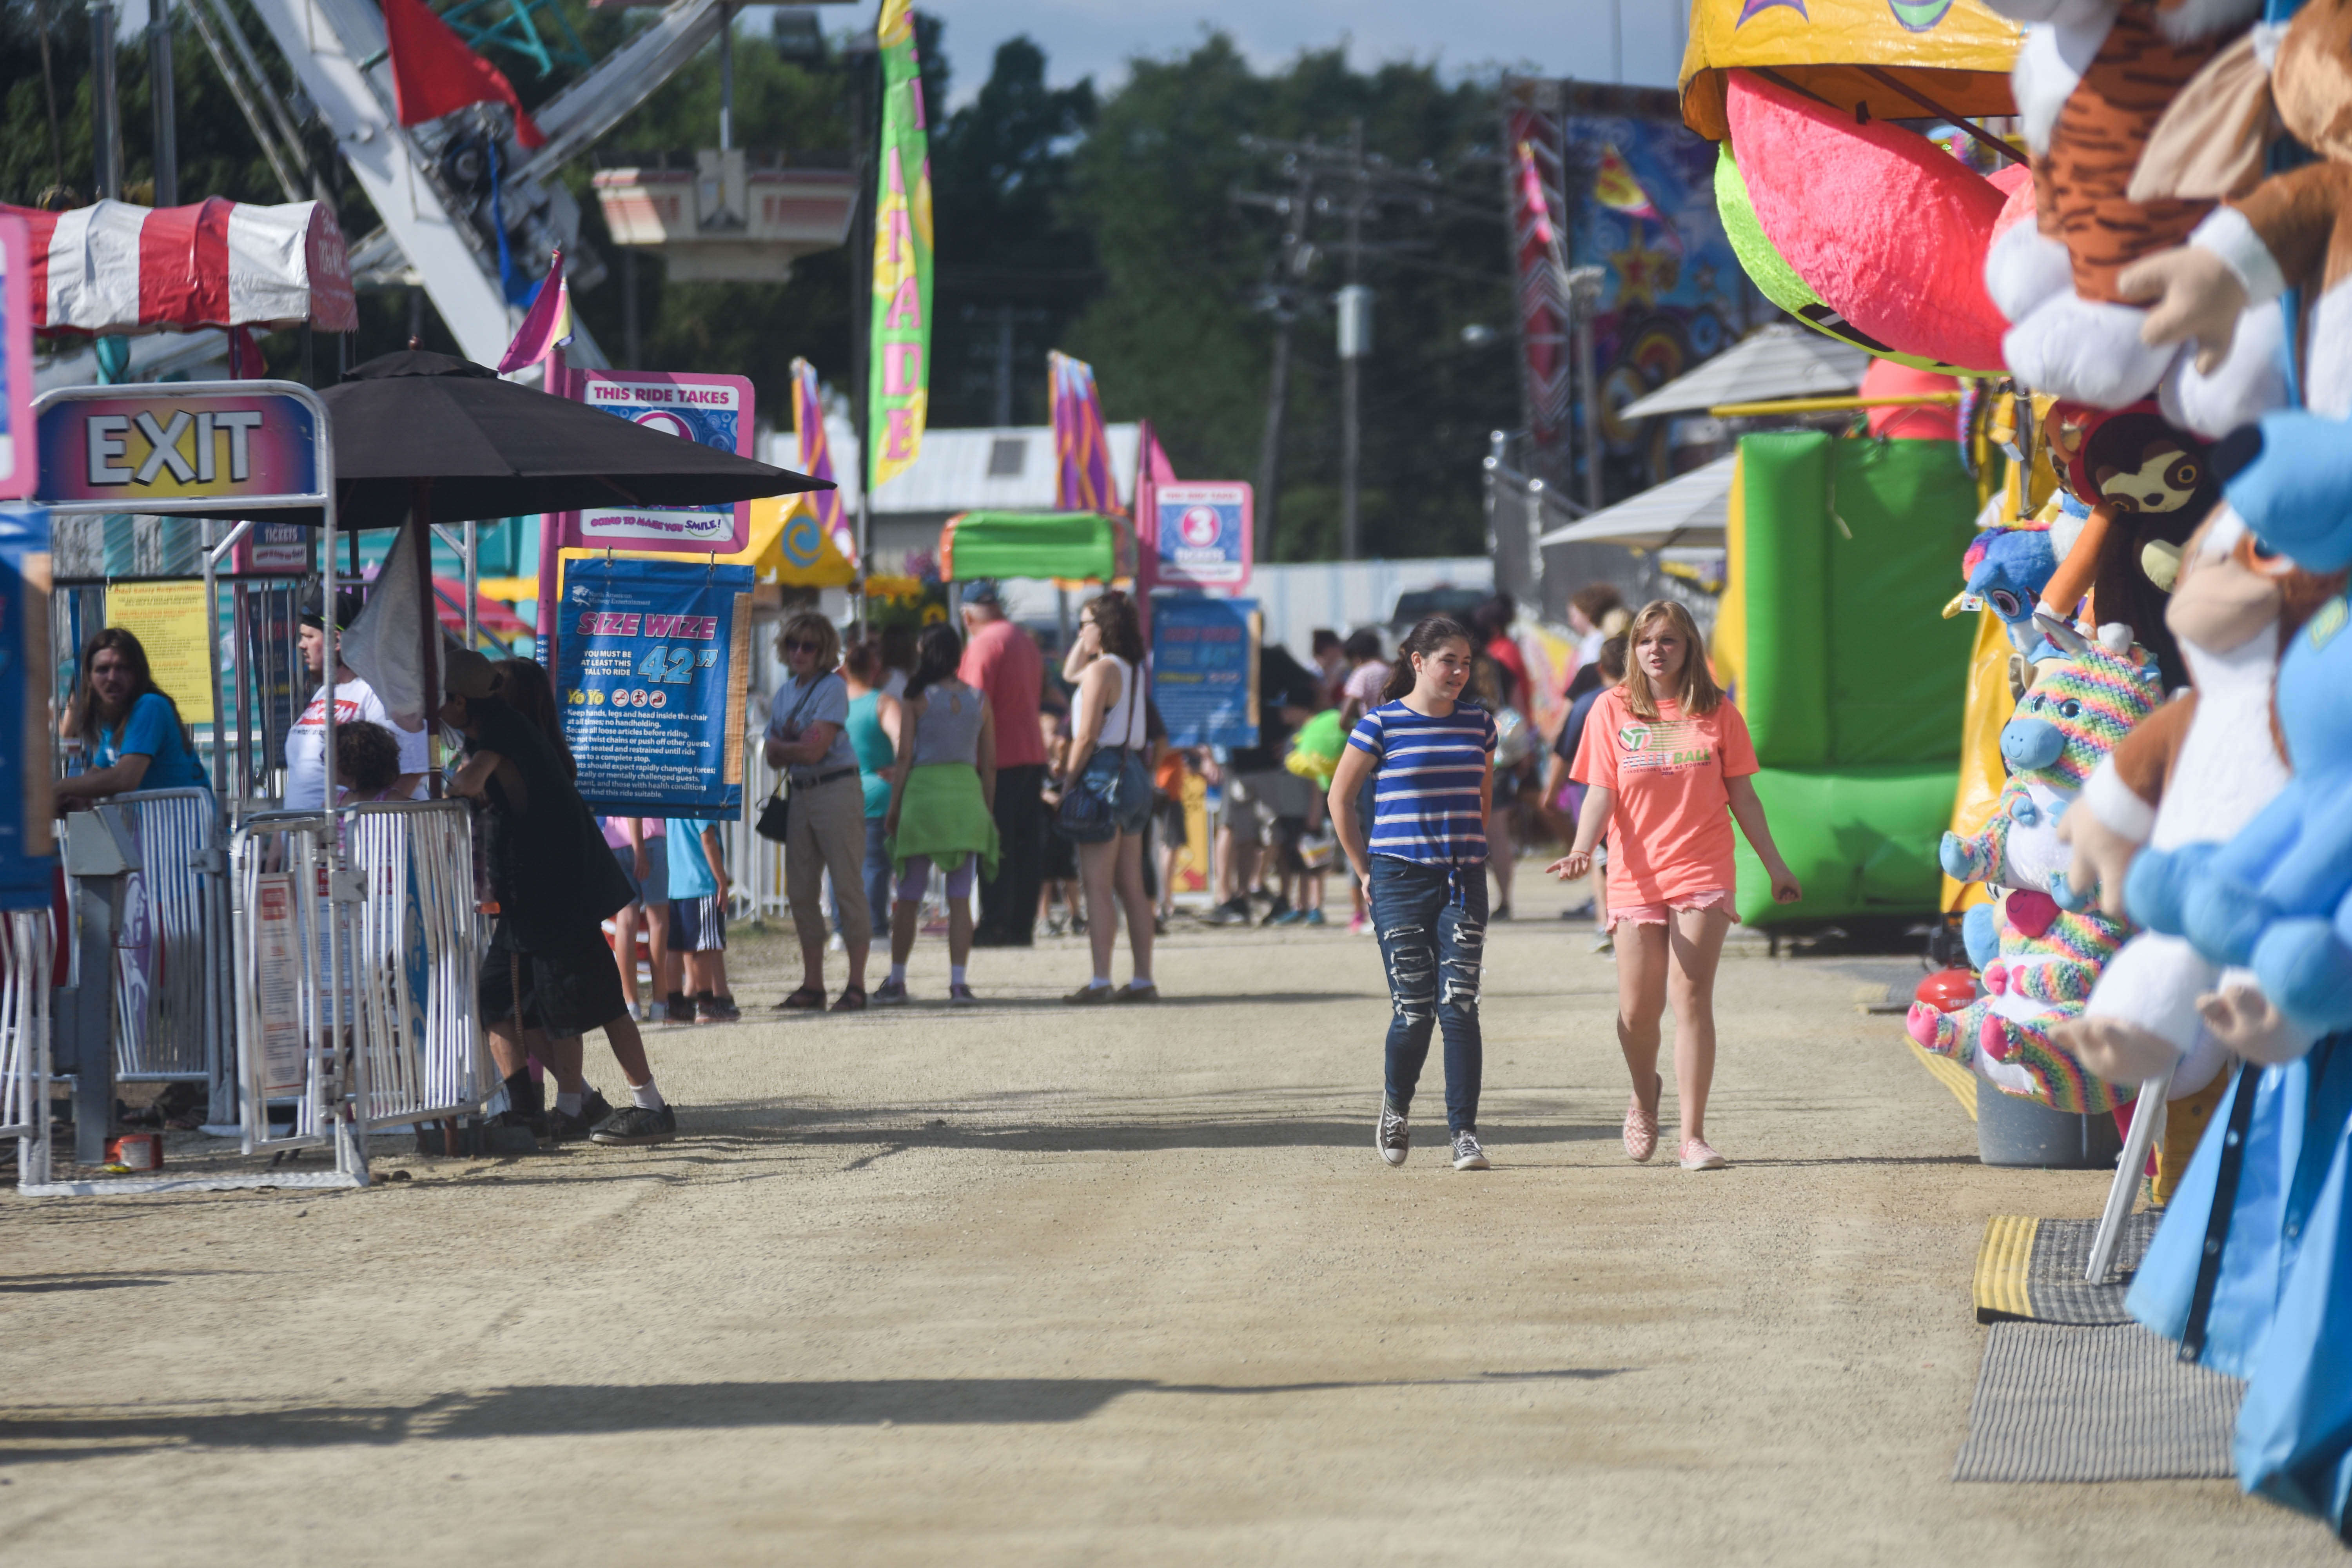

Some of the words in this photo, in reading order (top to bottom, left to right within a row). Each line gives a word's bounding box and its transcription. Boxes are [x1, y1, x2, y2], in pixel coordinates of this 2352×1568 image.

[594, 387, 630, 400] THIS
[635, 388, 672, 402] RIDE
[678, 390, 730, 404] TAKES
[87, 410, 263, 486] EXIT
[591, 516, 622, 527] GOING
[623, 516, 636, 524] TO
[637, 517, 664, 530] MAKE
[664, 523, 684, 532] YOU
[684, 519, 721, 531] SMILE!
[1189, 509, 1213, 542] 3
[265, 525, 298, 543] TICKETS
[577, 612, 642, 637] SIZE
[645, 613, 718, 640] WIZE
[568, 709, 584, 717] Keep
[585, 709, 607, 718] hands,
[608, 710, 622, 719] legs
[615, 719, 661, 729] handholding.
[667, 729, 690, 739] riding.
[667, 738, 686, 746] other
[633, 755, 650, 763] stop.
[1623, 748, 1710, 769] VOLLEYBALL
[636, 764, 660, 773] rapidly
[661, 764, 693, 774] changing
[694, 766, 716, 775] forces;
[606, 772, 636, 780] mentally
[637, 773, 675, 782] challenged
[671, 783, 707, 791] conditions
